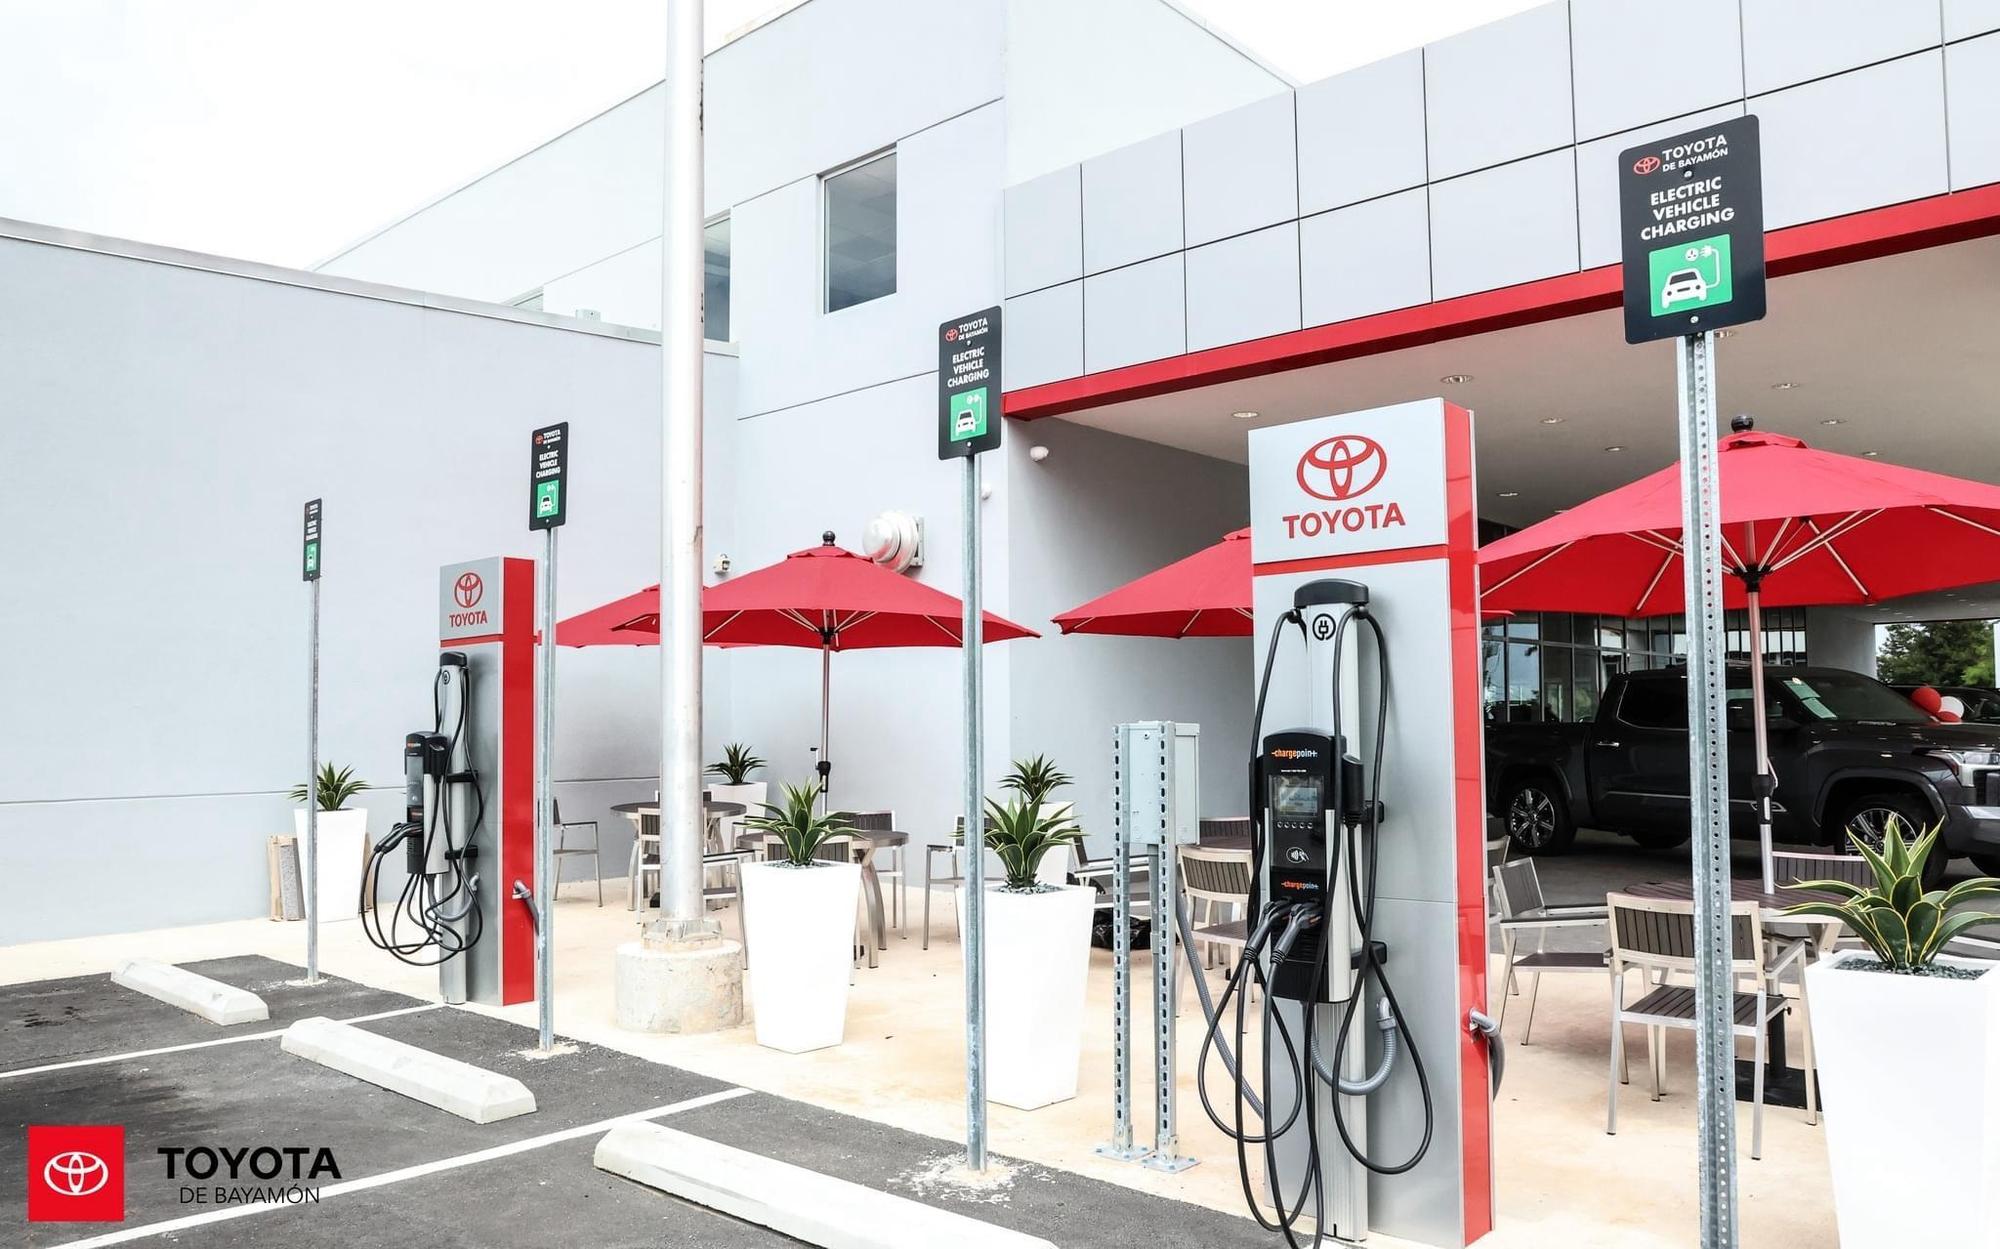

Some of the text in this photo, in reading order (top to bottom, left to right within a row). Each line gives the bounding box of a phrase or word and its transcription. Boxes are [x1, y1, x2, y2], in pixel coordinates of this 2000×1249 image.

[1662, 134, 1728, 161] TOYOTA
[1662, 147, 1728, 173] DE BAYAMÓN
[1650, 176, 1722, 206] ELECTRIC
[1653, 194, 1720, 221] VEHICLE
[1640, 207, 1735, 240] CHARGING
[958, 317, 988, 333] TOYOTA
[952, 346, 985, 364] ELECTRIC
[953, 359, 984, 374] VEHICLE
[947, 368, 990, 388] CHARGING
[1282, 502, 1406, 539] TOYOTA
[449, 610, 488, 628] TOYOTA
